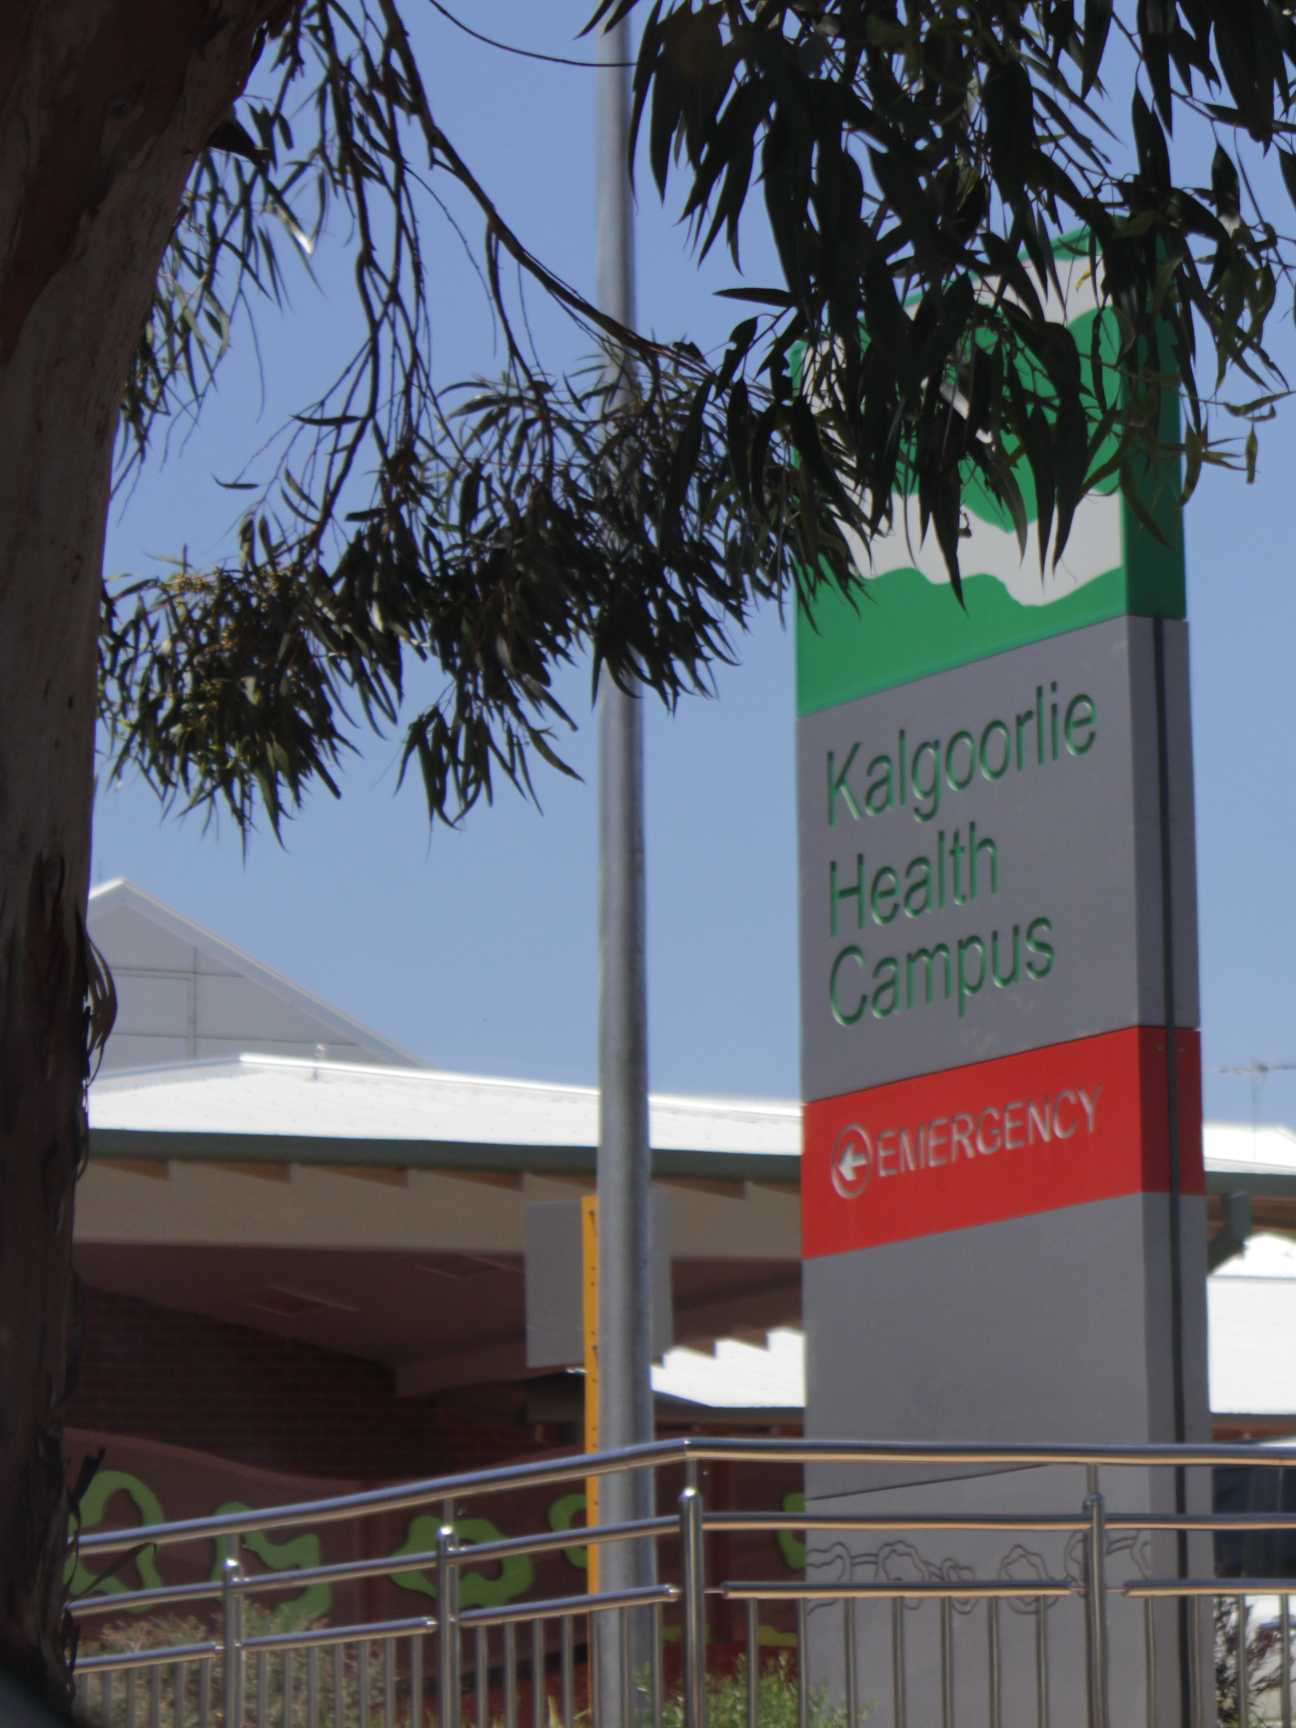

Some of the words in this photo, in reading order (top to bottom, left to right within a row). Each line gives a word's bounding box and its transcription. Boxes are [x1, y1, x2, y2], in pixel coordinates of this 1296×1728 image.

[826, 680, 1097, 828] Kalgoorlie
[829, 820, 999, 937] Health
[829, 916, 1056, 1027] Campus
[877, 1084, 1104, 1178] EMERGENCY
